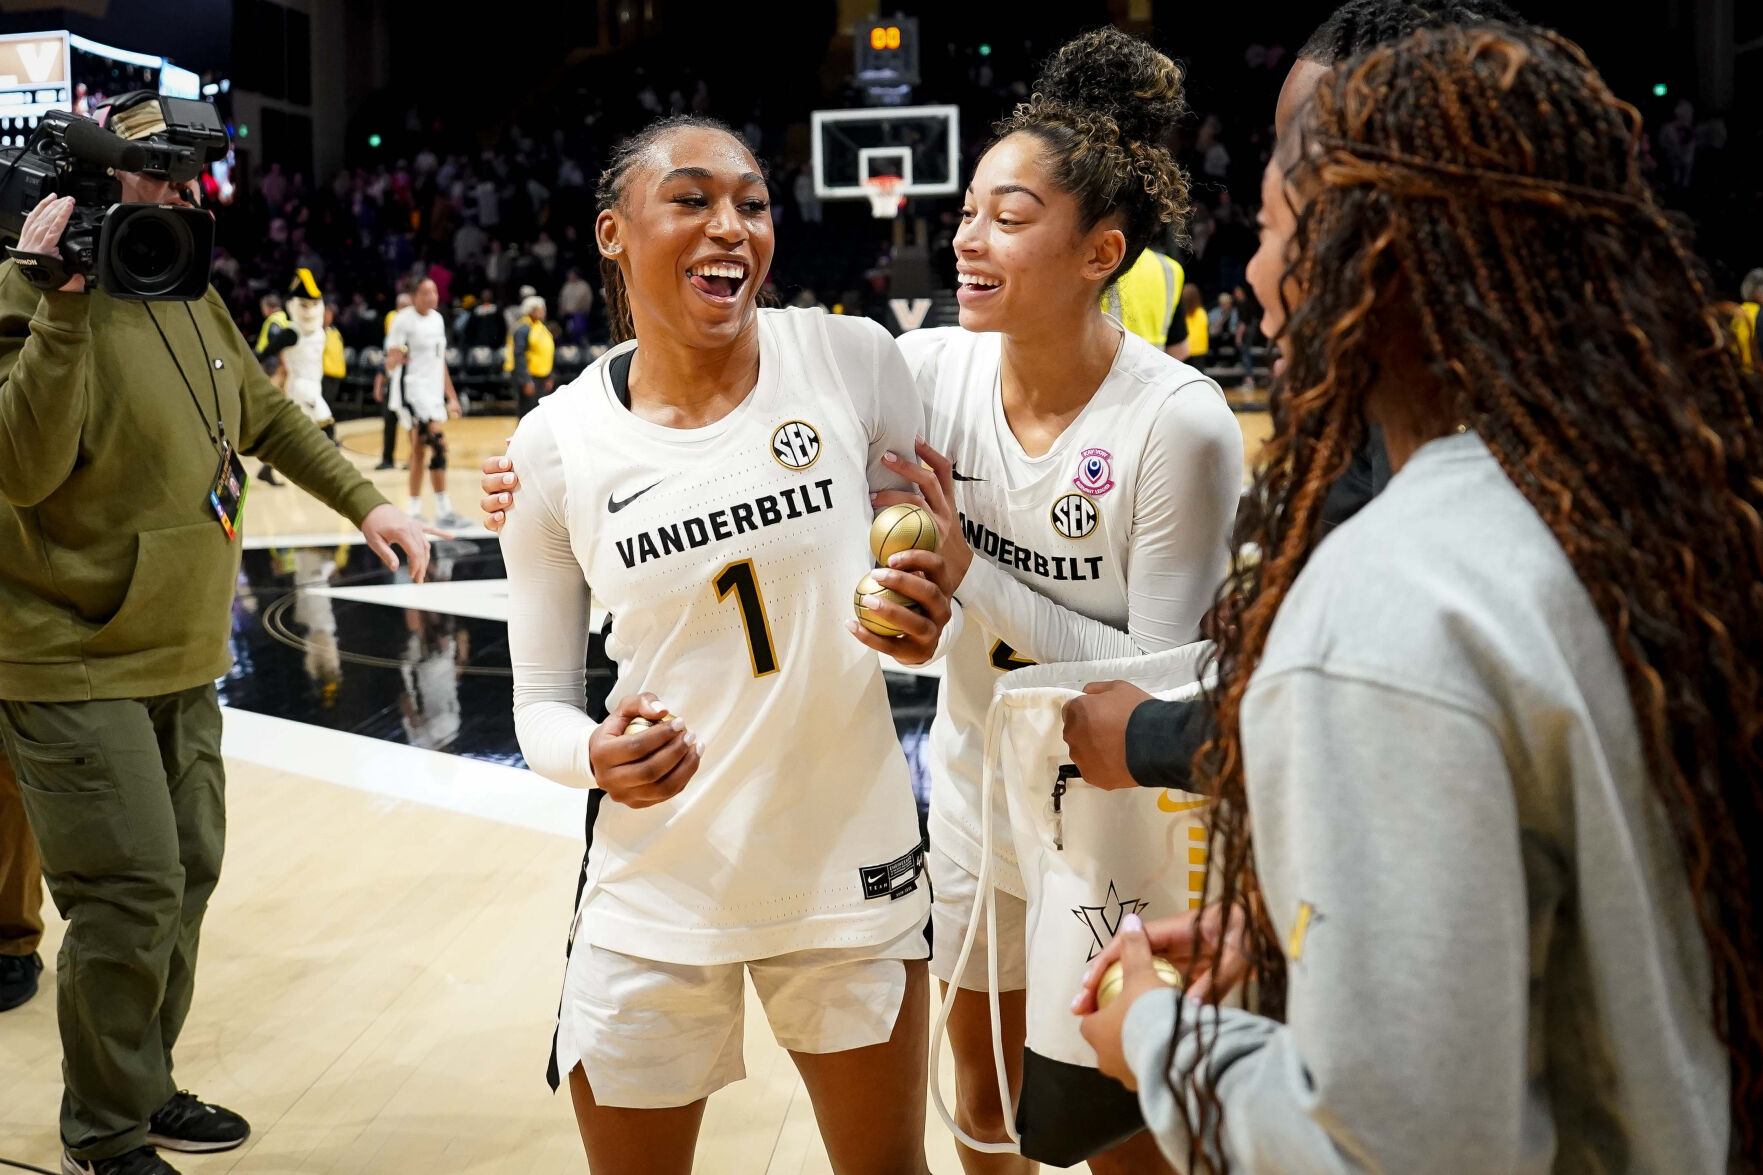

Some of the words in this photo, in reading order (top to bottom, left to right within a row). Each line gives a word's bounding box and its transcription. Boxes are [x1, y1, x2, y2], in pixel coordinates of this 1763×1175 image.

[16, 42, 60, 82] V
[889, 298, 932, 331] V
[773, 421, 820, 468] SEC
[616, 479, 834, 569] VANDERBILT
[1053, 495, 1097, 538] SEC
[959, 512, 1103, 581] ANDERBILT
[712, 558, 780, 678] 1
[868, 883, 888, 891] TEAM
